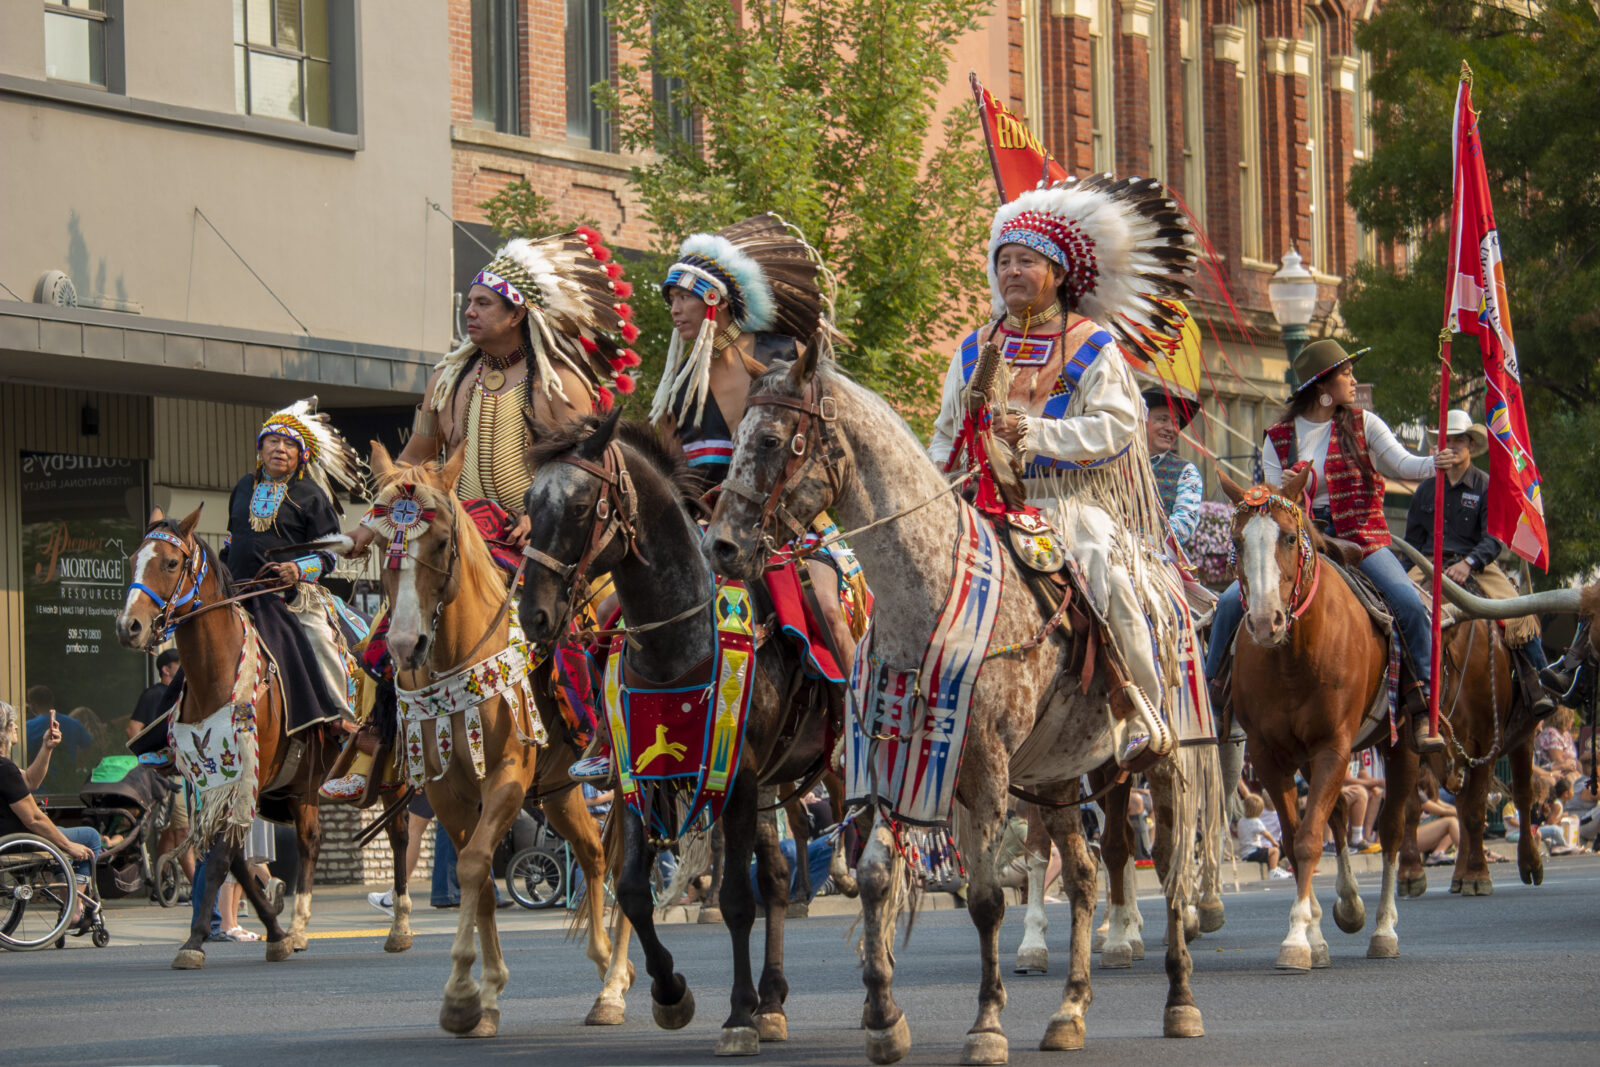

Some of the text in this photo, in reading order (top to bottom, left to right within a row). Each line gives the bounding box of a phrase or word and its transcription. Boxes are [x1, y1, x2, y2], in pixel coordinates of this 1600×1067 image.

[35, 518, 103, 584] Premier
[61, 558, 121, 579] MORTGAGE
[61, 588, 122, 600] RESOURCES
[88, 607, 100, 616] Equal
[100, 608, 117, 617] Housing
